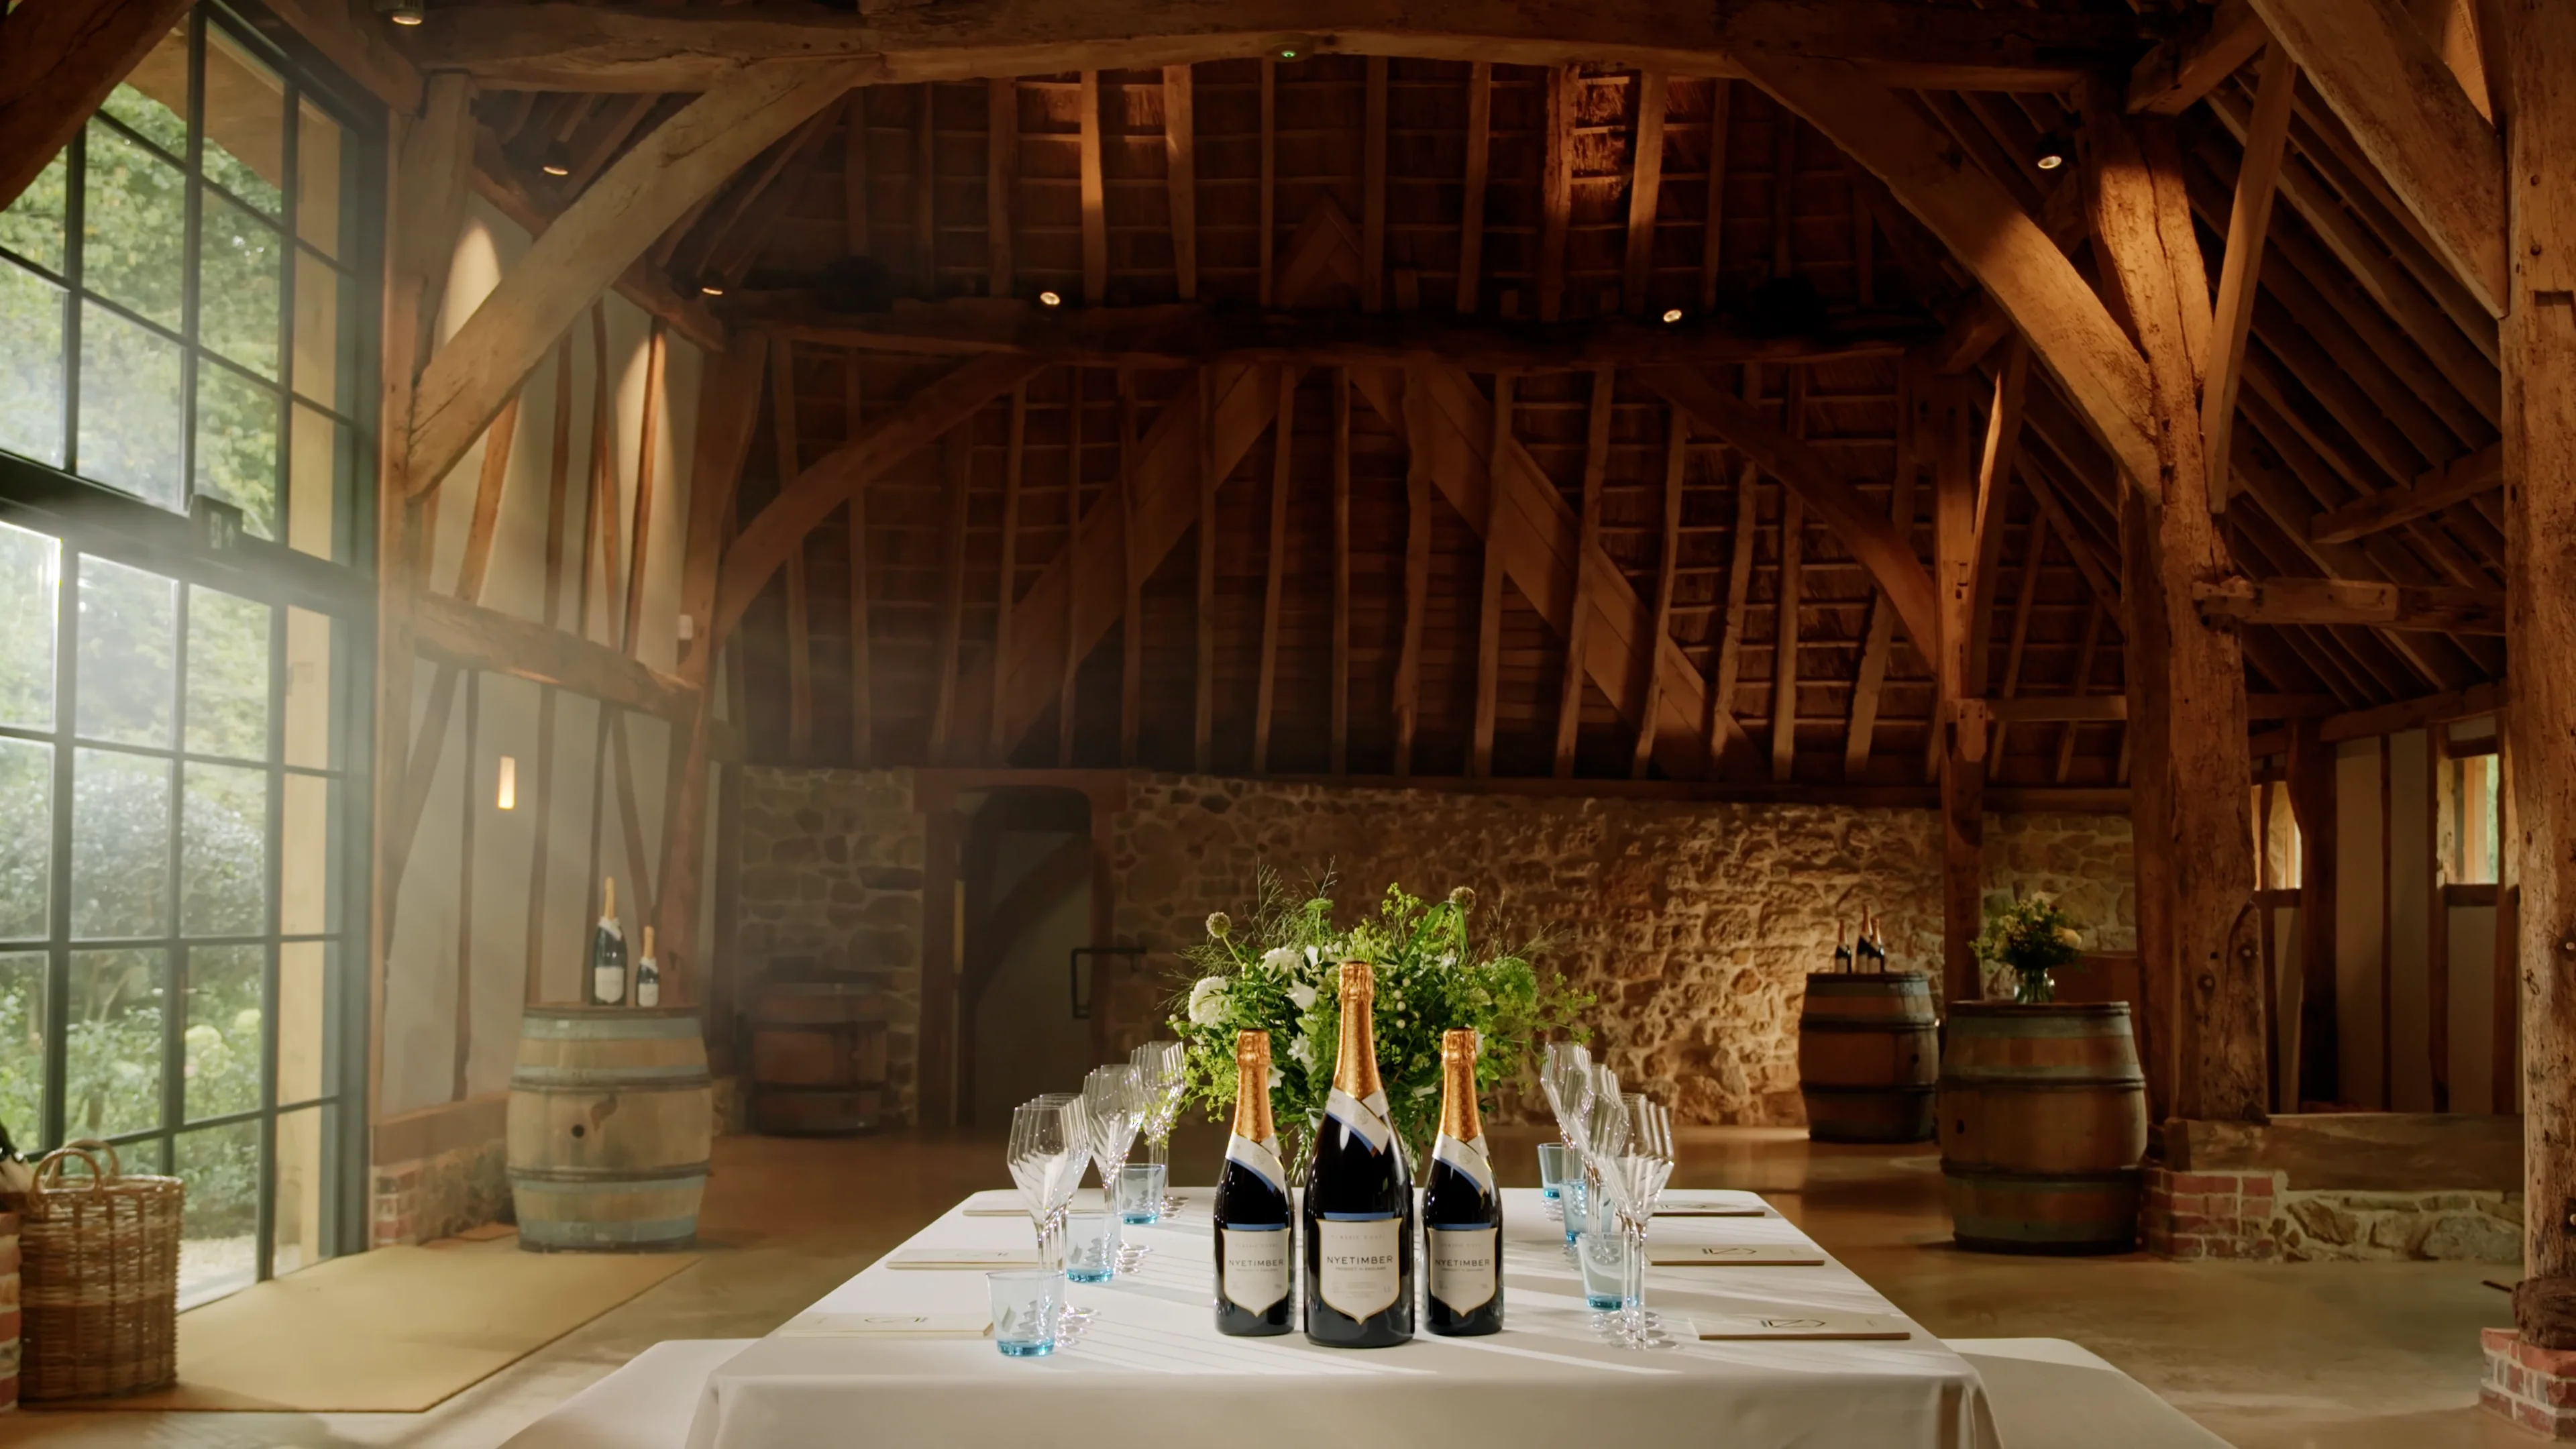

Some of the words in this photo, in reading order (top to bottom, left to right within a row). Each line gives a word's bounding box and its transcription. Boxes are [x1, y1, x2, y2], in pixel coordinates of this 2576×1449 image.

[1228, 1258, 1284, 1267] NYETIMBER
[1326, 1255, 1393, 1265] NYETIMBER
[1434, 1258, 1491, 1267] NYETIMBER
